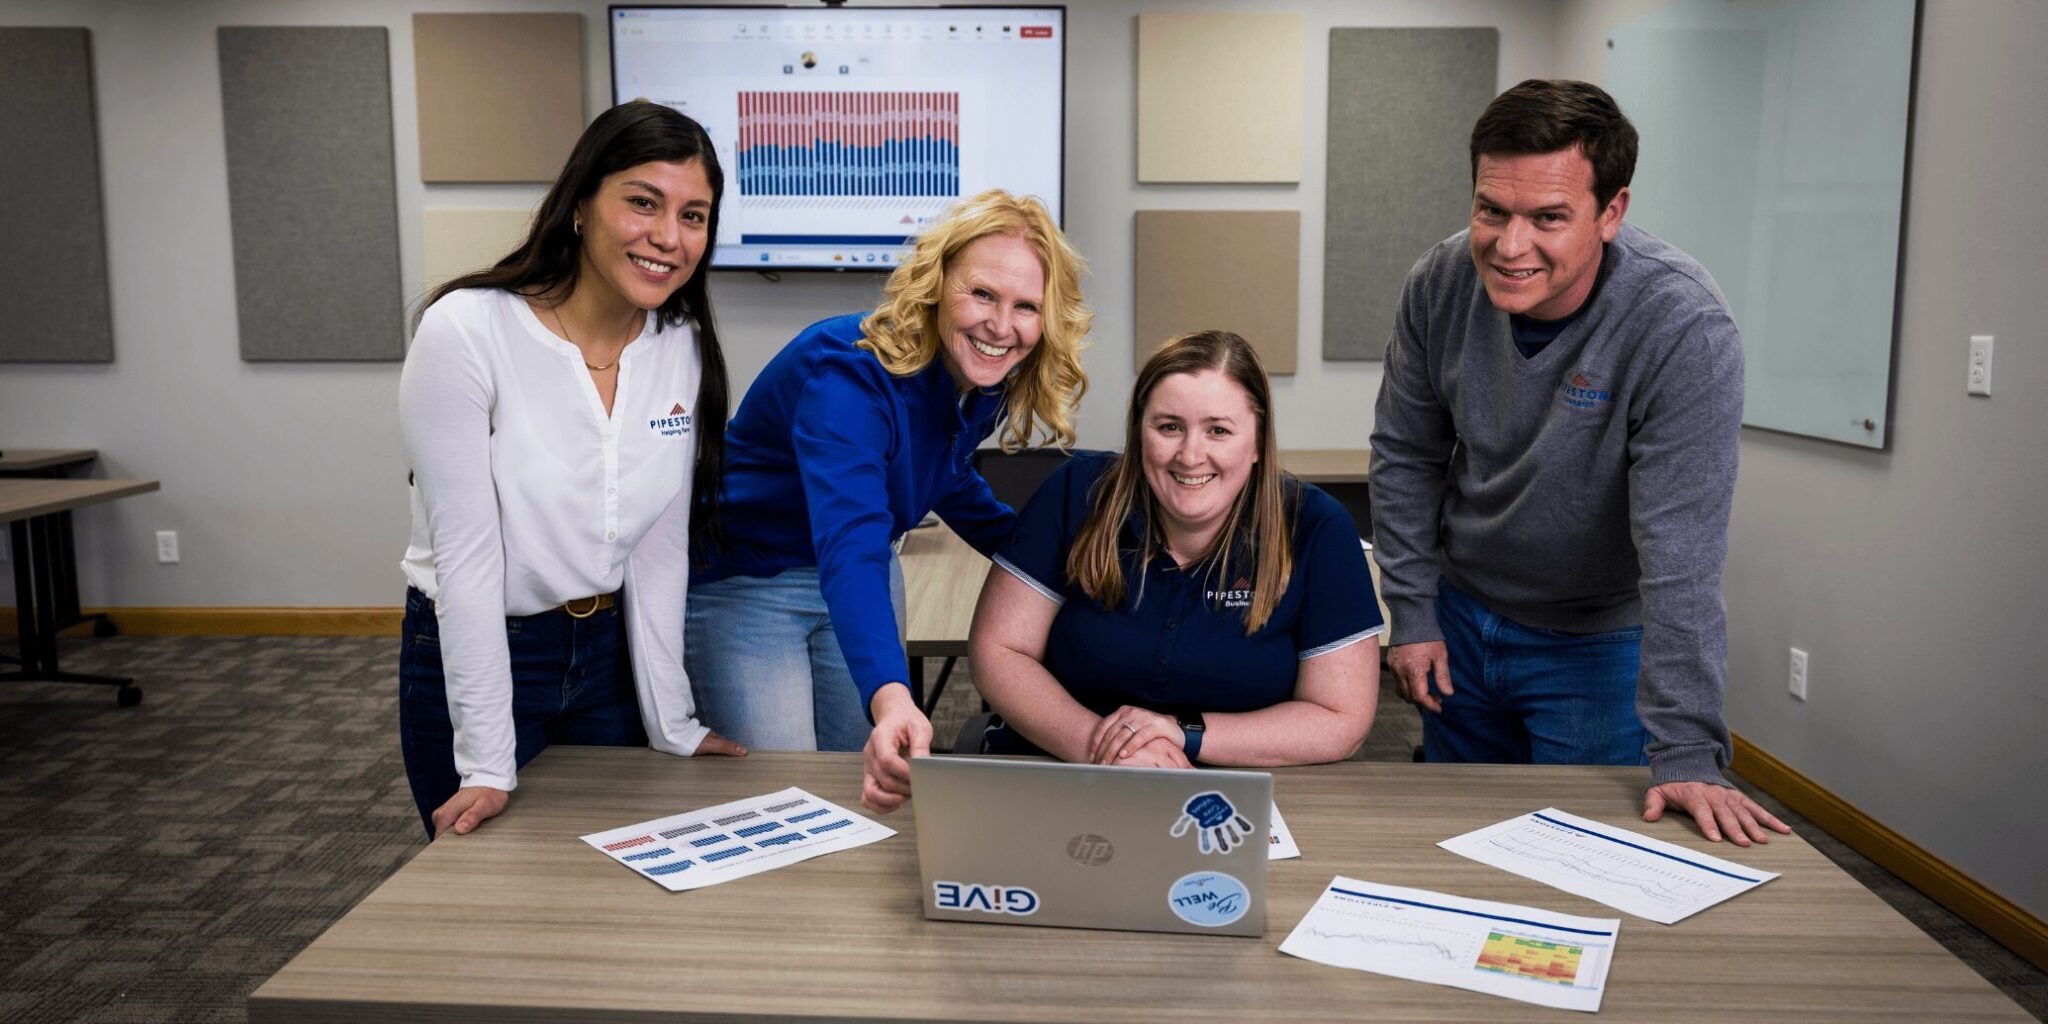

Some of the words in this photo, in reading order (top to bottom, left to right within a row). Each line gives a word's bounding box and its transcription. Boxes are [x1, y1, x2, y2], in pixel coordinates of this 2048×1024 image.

[650, 416, 692, 429] PIPESTO
[1072, 833, 1109, 866] hp
[1173, 890, 1218, 908] WELL
[1207, 893, 1242, 916] Be
